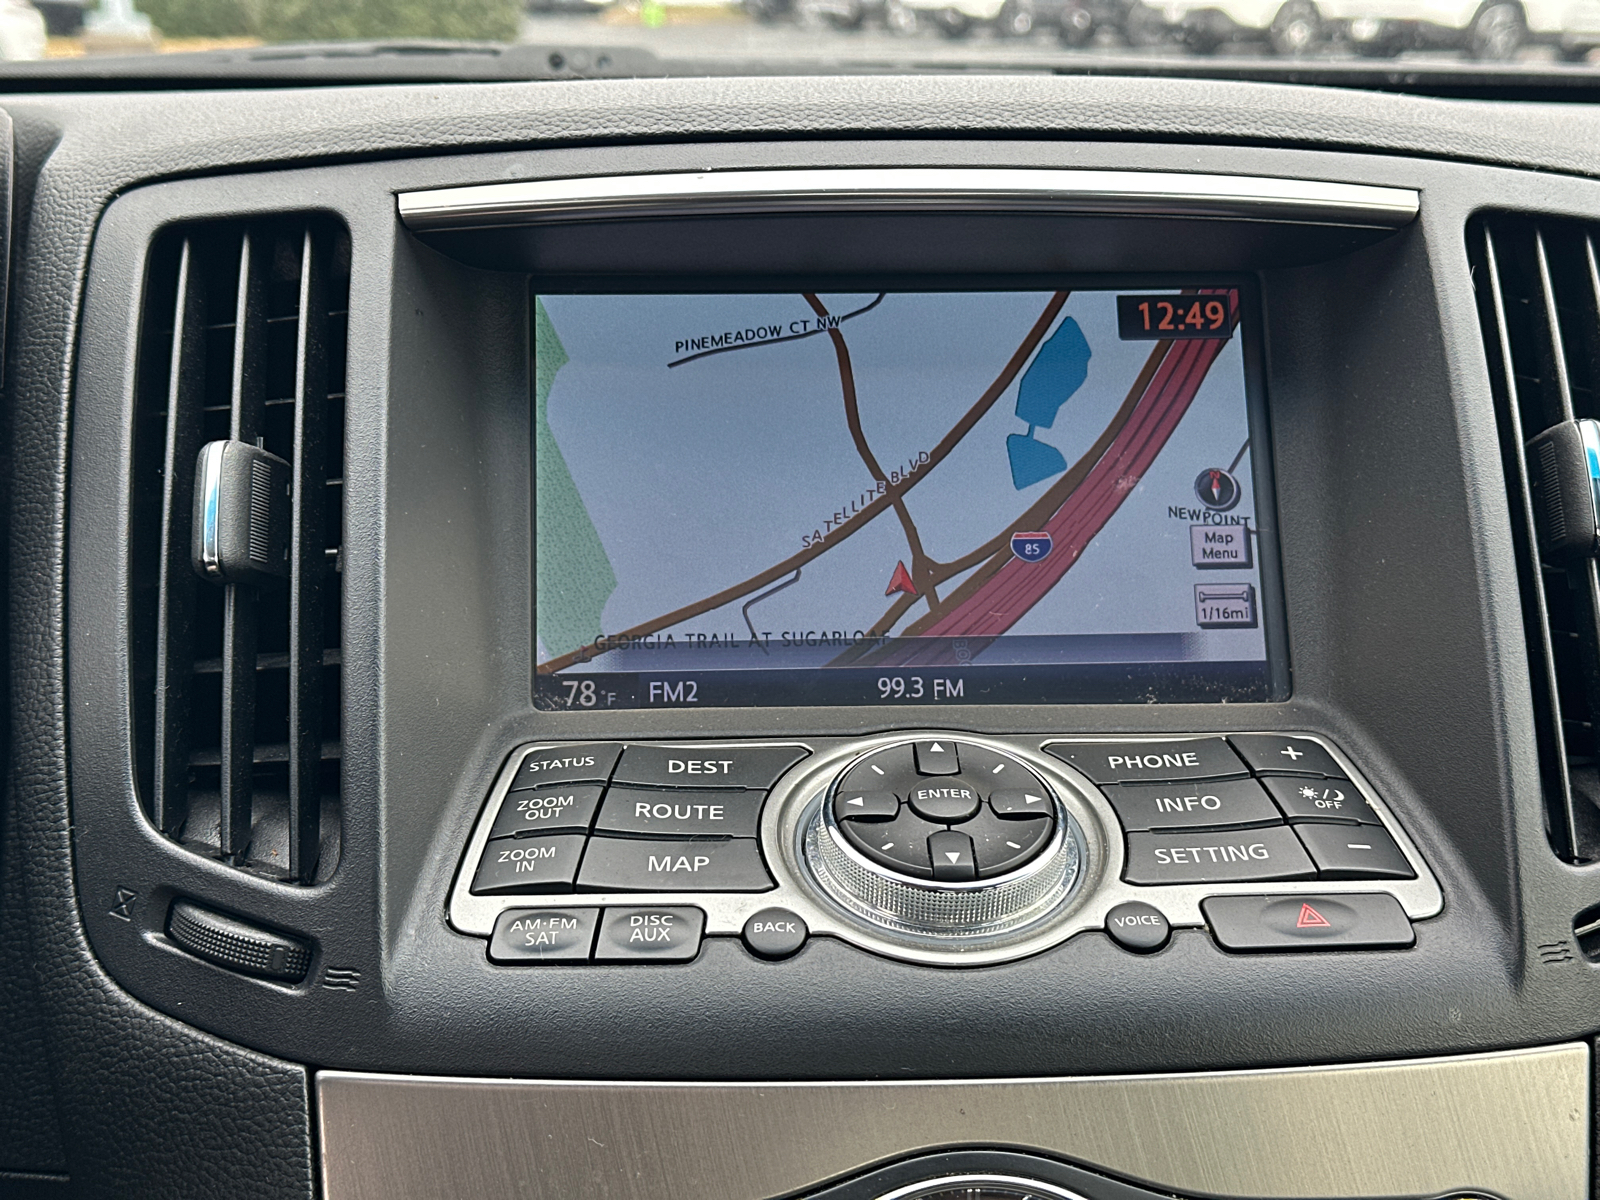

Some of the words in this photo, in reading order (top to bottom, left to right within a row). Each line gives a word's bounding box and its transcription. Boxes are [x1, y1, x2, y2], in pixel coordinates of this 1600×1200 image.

[1138, 301, 1225, 331] 12:49
[675, 325, 782, 353] PINEMEADOW
[790, 319, 810, 334] CT
[817, 315, 841, 330] NW
[802, 481, 886, 548] SATELLITE
[891, 451, 929, 484] BLVD
[1168, 506, 1251, 528] NEWPOINT
[1205, 532, 1234, 545] Map
[1025, 543, 1040, 555] 85
[1202, 547, 1238, 559] Menu
[1201, 607, 1249, 621] 1/16mi
[594, 634, 677, 650] GEORGIA
[685, 633, 740, 649] TRAIL
[748, 632, 772, 648] AT
[781, 630, 890, 647] SUGARLOAF
[562, 680, 597, 706] 78
[649, 681, 698, 703] FM2
[877, 677, 924, 698] 99.3
[933, 679, 964, 697] FM
[529, 756, 595, 772] STATUS
[668, 759, 733, 774] DEST
[1108, 752, 1200, 769] PHONE
[917, 788, 972, 800] ENTER
[517, 795, 574, 811] ZOOM
[1155, 795, 1221, 813] INFO
[1314, 799, 1342, 810] OFF
[525, 807, 563, 820] OUT
[635, 802, 724, 820] ROUTE
[497, 847, 556, 862] ZOOM
[1154, 843, 1269, 865] SETTING
[515, 860, 535, 873] IN
[647, 855, 710, 872] MAP
[630, 915, 673, 927] DISC
[753, 921, 796, 933] BACK
[1114, 914, 1161, 927] VOICE
[524, 931, 559, 946] SAT
[629, 927, 671, 942] AUX
